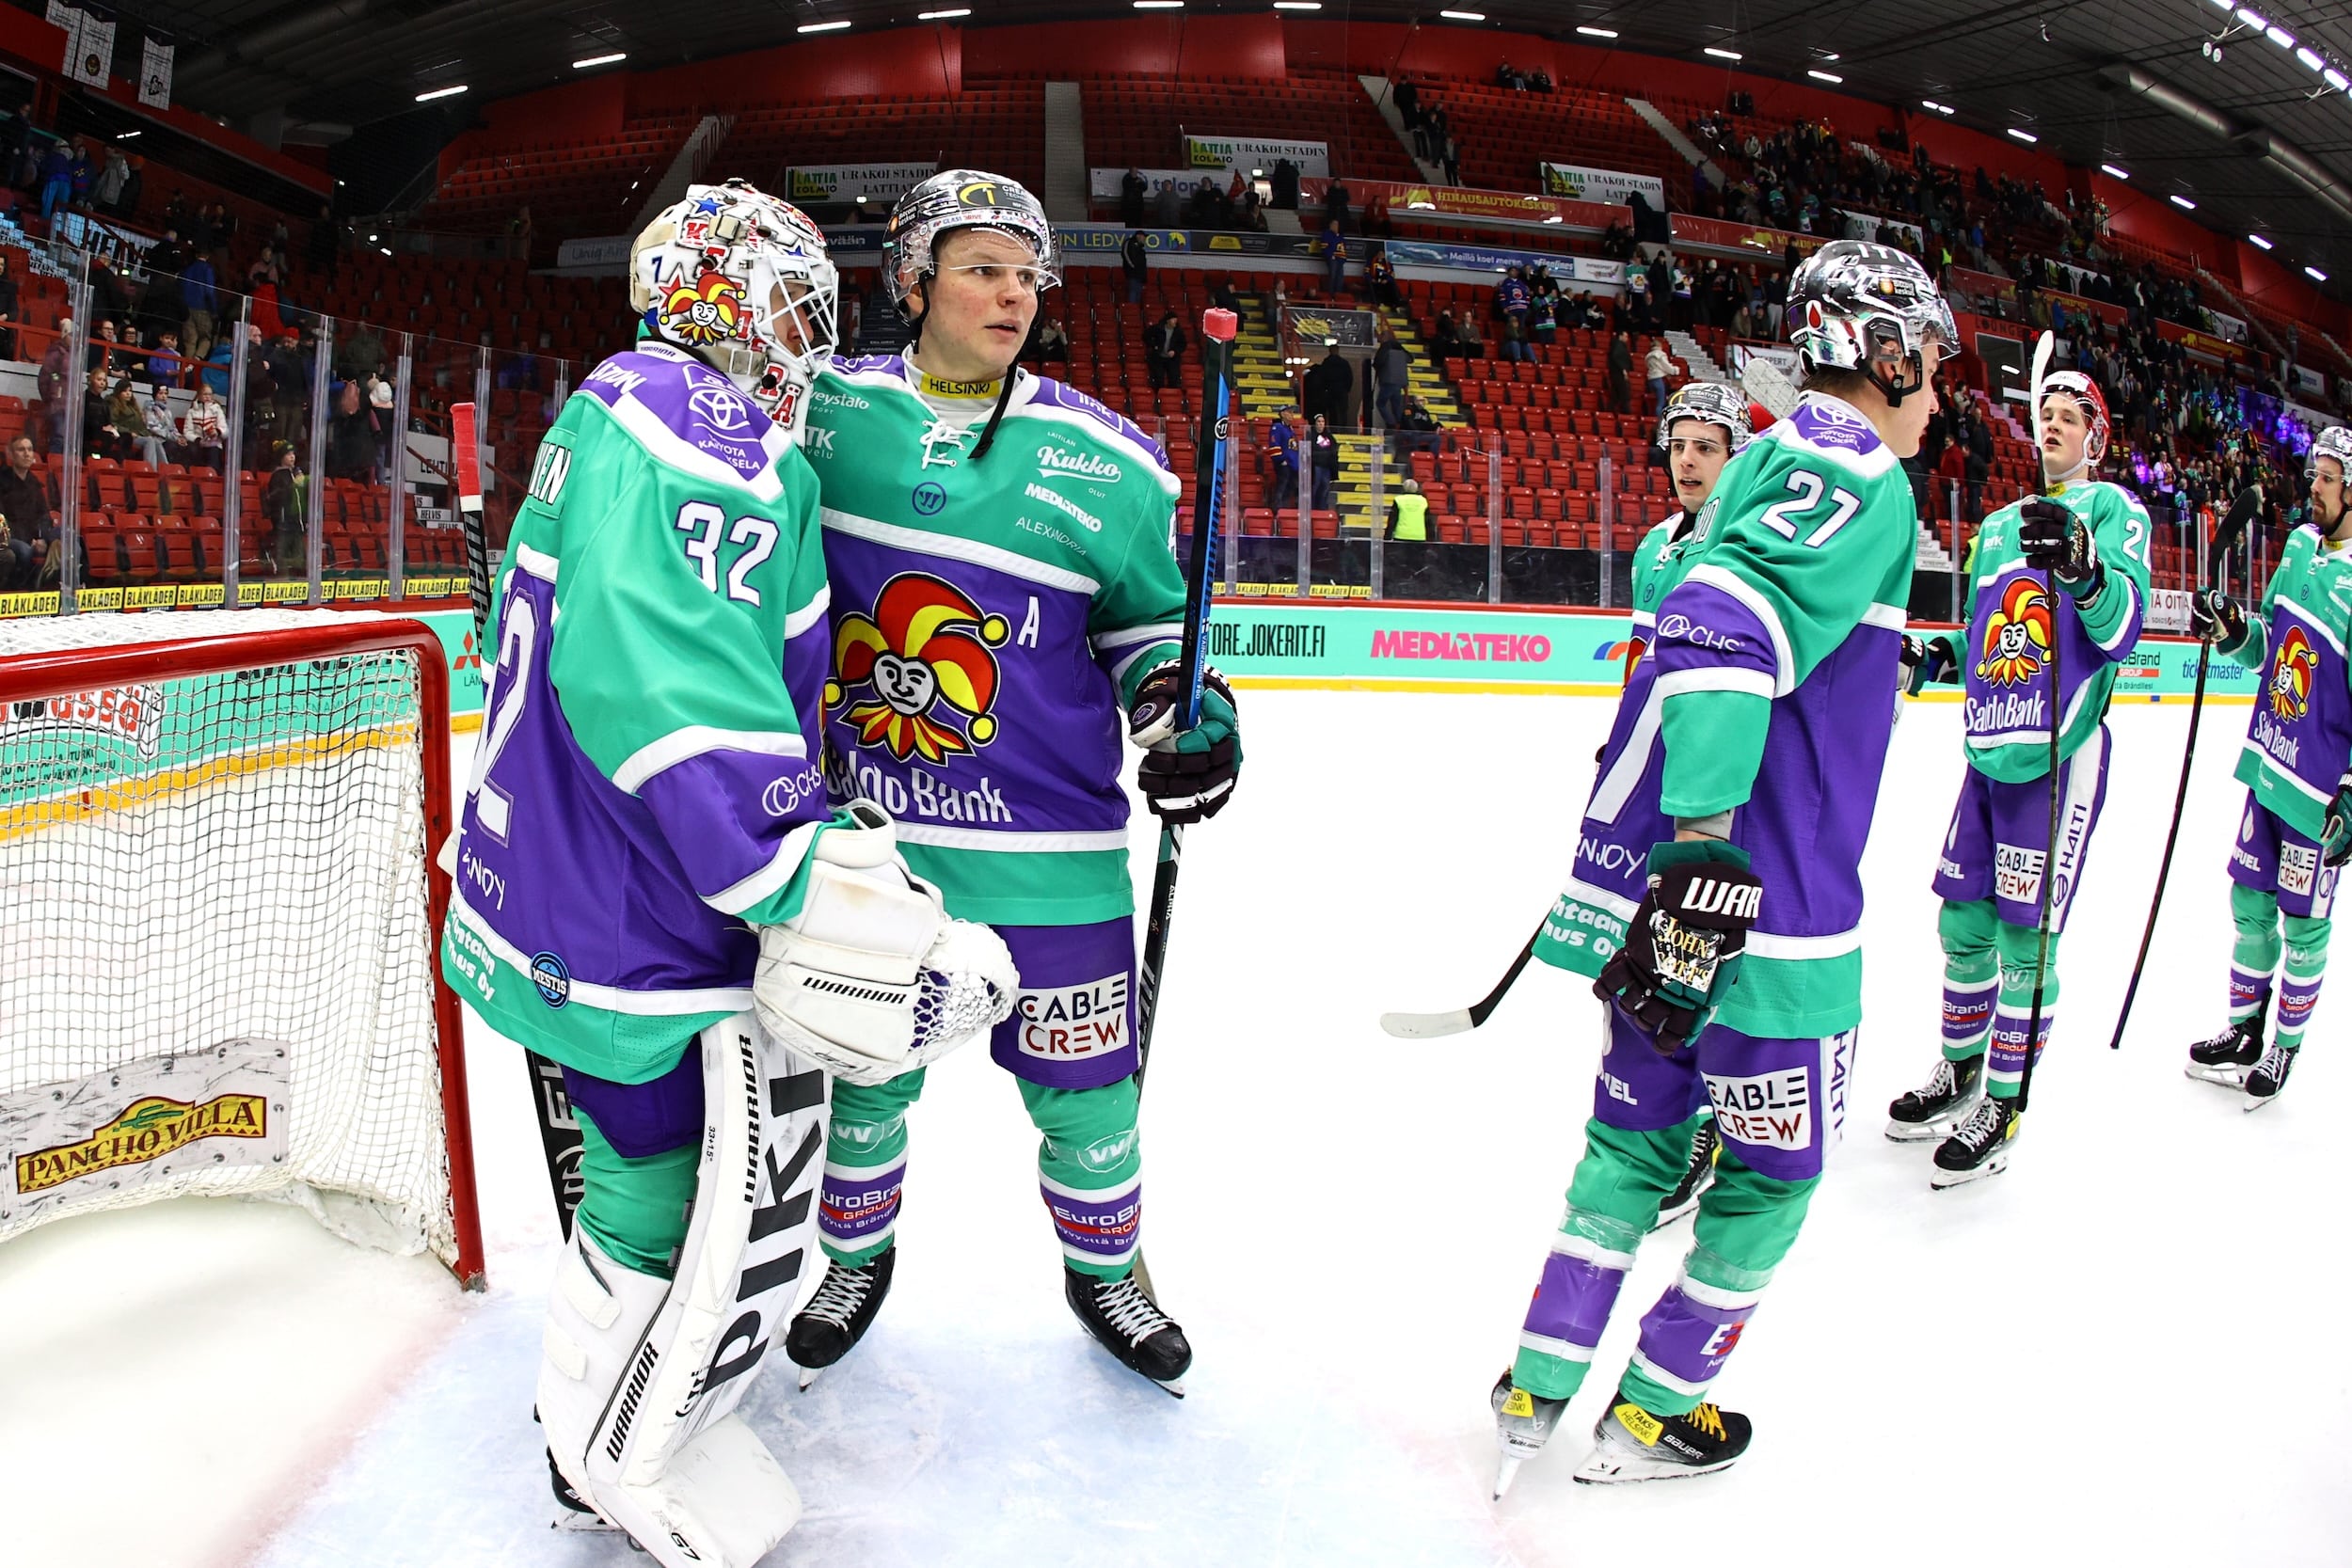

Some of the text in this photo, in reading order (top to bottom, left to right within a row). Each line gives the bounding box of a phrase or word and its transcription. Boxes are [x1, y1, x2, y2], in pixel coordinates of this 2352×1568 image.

[1258, 157, 1306, 169] LATAT
[1285, 146, 1326, 157] STADIN
[1556, 169, 1585, 184] ATTIA
[1084, 233, 1160, 249] LEDVO
[810, 390, 870, 411] veystalo
[1036, 445, 1121, 479] Kukko
[1025, 482, 1104, 533] MEDIATEKO
[1088, 487, 1107, 499] OLUT
[1758, 468, 1862, 548] 27
[674, 499, 781, 609] 32
[77, 589, 121, 610] ÅKLÄDER
[127, 587, 175, 606] BLÅKLÄDER
[180, 586, 224, 604] BLÅKLÄDER
[265, 583, 309, 600] BLÅKLÄDER
[337, 580, 380, 597] BLÅKLÄDER
[1017, 595, 1040, 649] A
[1205, 623, 1326, 658] ORE.JOKERIT.FI
[1370, 628, 1552, 663] MEDIATEKO
[2121, 651, 2161, 666] oBrand
[2182, 657, 2245, 681] ticktmaster
[911, 766, 1014, 824] Bank
[2059, 803, 2088, 870] HALTI
[1576, 837, 1646, 879] NJOY
[1995, 847, 2044, 876] CABLE
[2280, 845, 2316, 871] CABLE
[2279, 864, 2310, 891] CREW
[1659, 916, 1710, 959] JOHN
[532, 967, 567, 996] MESTIS
[802, 975, 908, 1006] WARRIOR
[1018, 977, 1128, 1023] CABLE
[1025, 1015, 1123, 1055] CREW
[1707, 1074, 1807, 1113] CABLE
[1829, 1030, 1850, 1132] HALTI
[739, 1033, 760, 1204] WARRIOR
[1716, 1109, 1803, 1145] CREW
[26, 1100, 257, 1183] PANCHO VILLA
[820, 1181, 902, 1209] uroBra
[842, 1197, 894, 1221] GROUP
[1053, 1200, 1142, 1227] EuroBr
[605, 1339, 660, 1464] WARRIOR
[1620, 1410, 1652, 1440] HELSINKI
[1632, 1410, 1657, 1431] TAKSI
